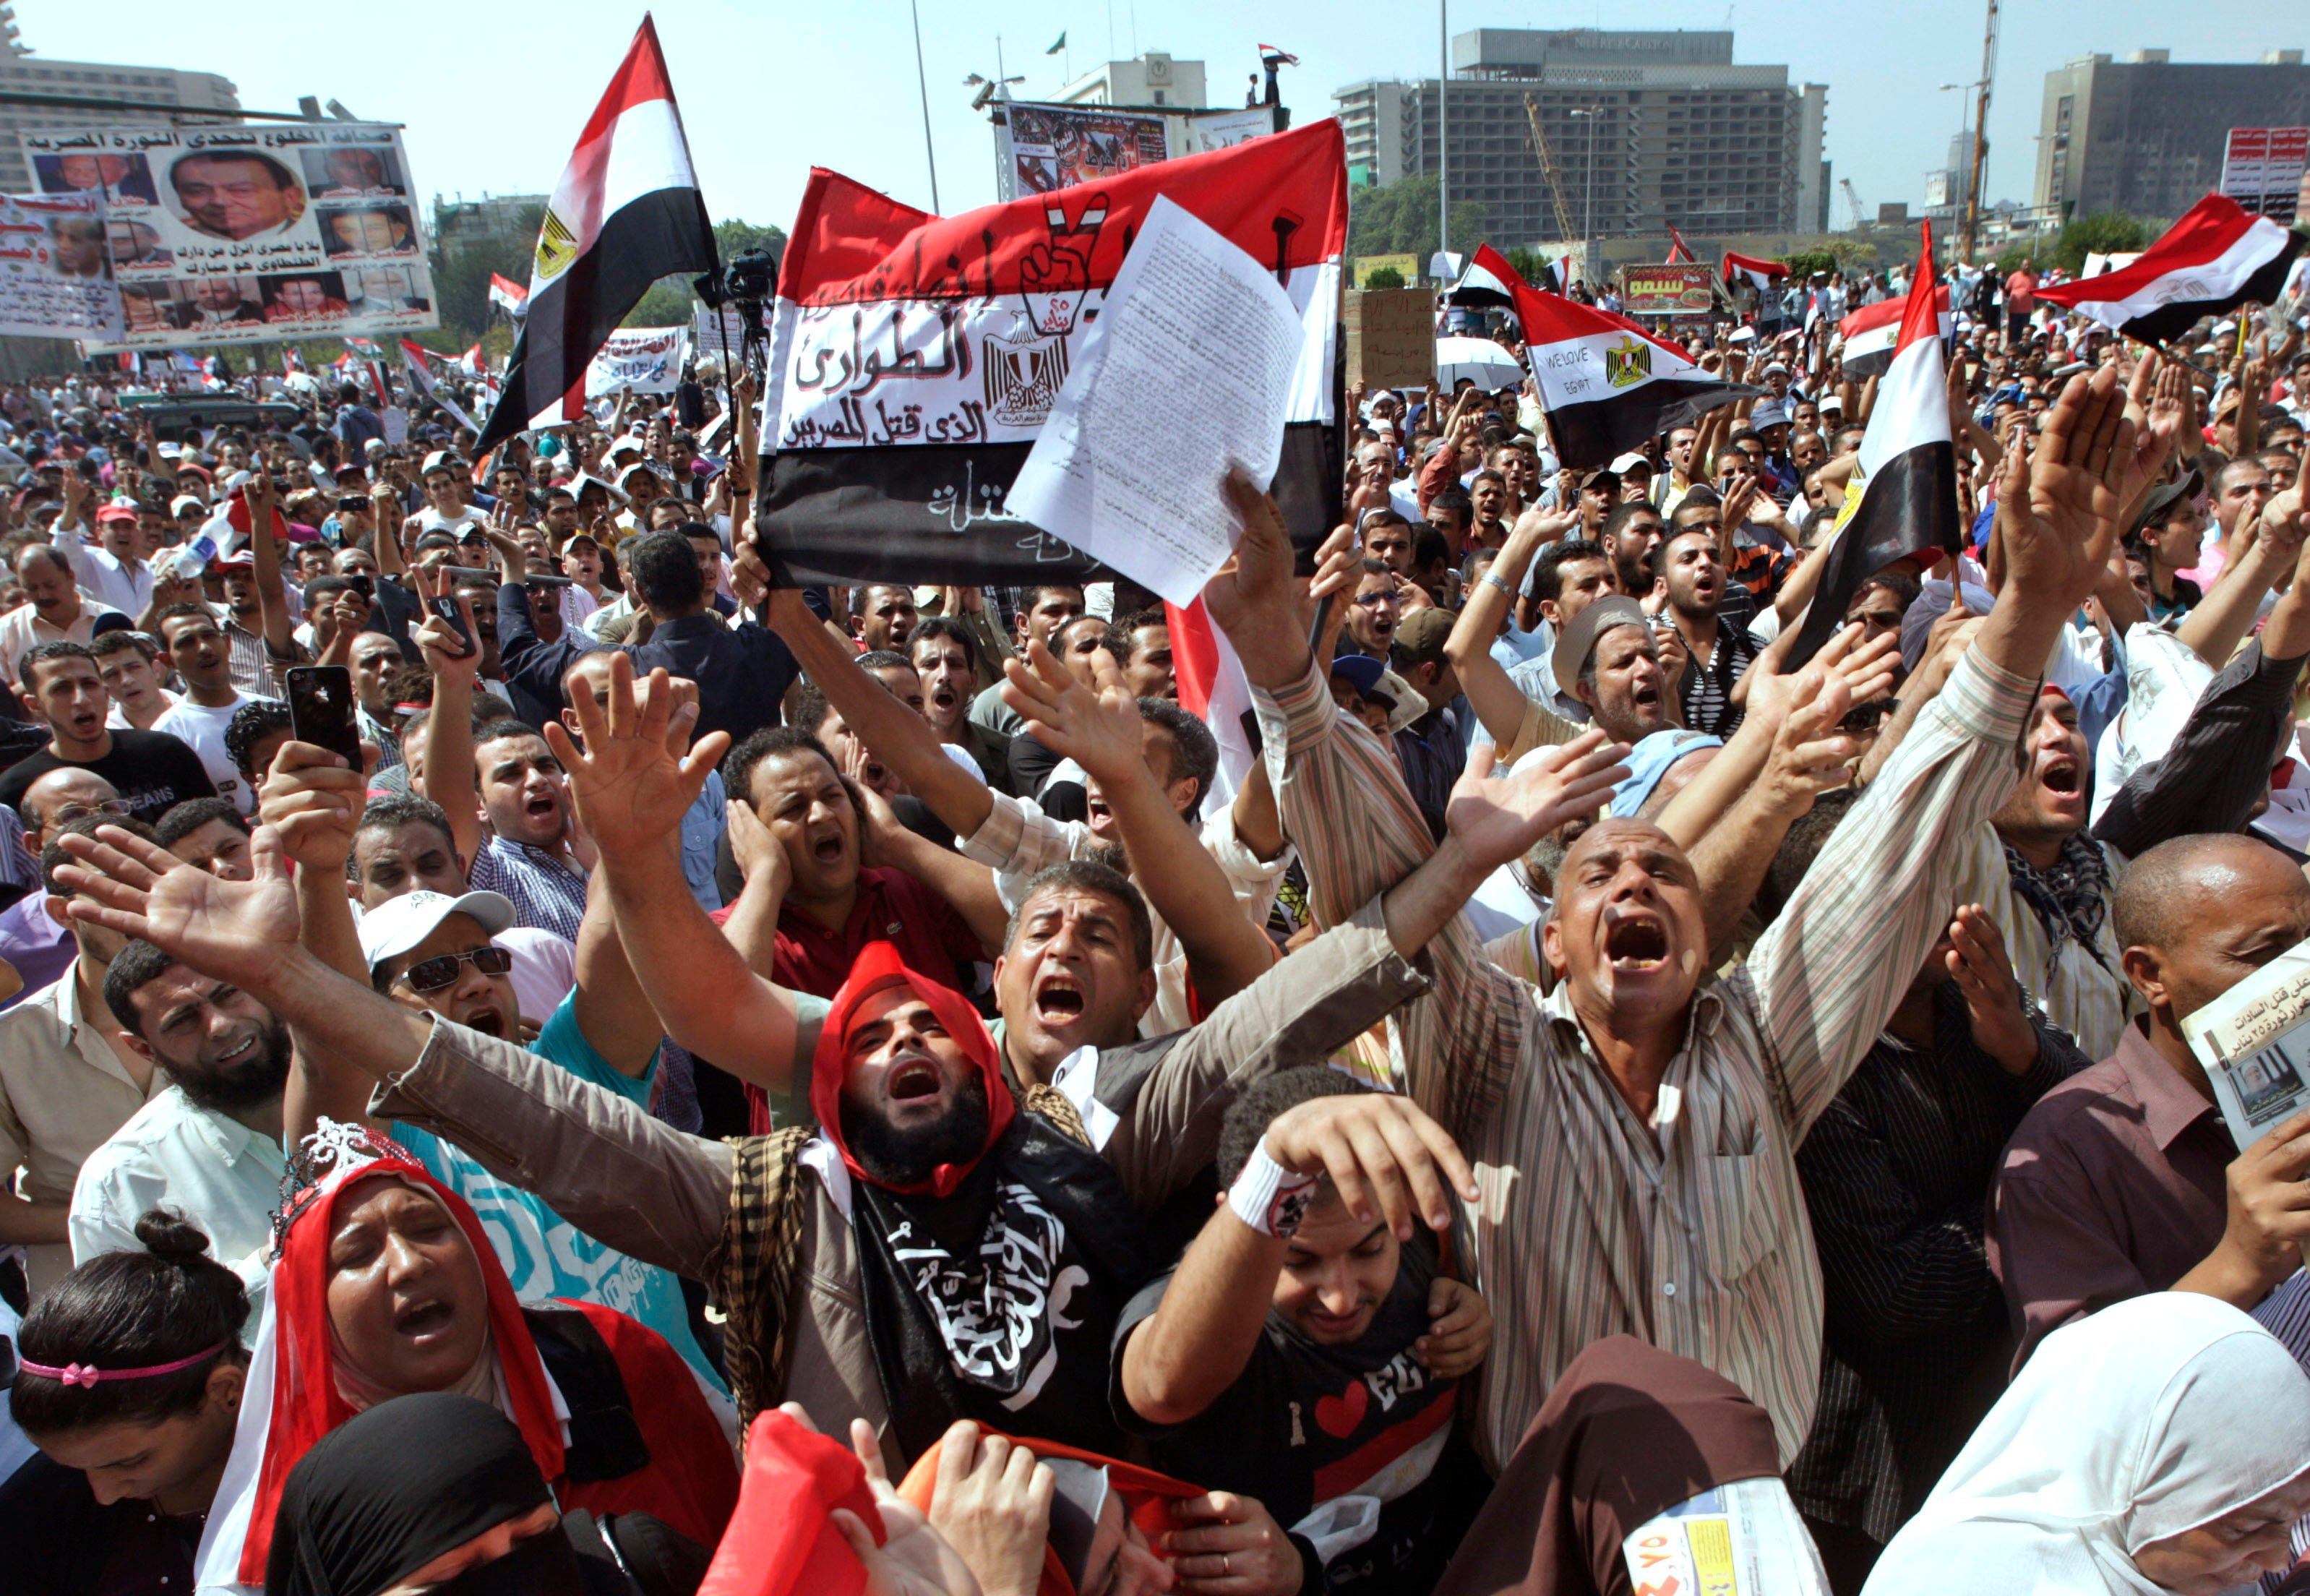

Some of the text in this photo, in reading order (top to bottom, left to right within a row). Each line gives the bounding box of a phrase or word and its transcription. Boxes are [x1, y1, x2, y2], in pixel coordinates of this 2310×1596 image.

[1545, 347, 1589, 369] WE LOVE
[1563, 379, 1590, 395] EGYPT
[872, 399, 922, 445] قتل
[131, 786, 175, 810] EANS
[2270, 986, 2289, 1010] قتل
[2234, 1000, 2270, 1030] السادات
[2263, 1009, 2288, 1031] ثورة
[2232, 1034, 2256, 1058] يناير
